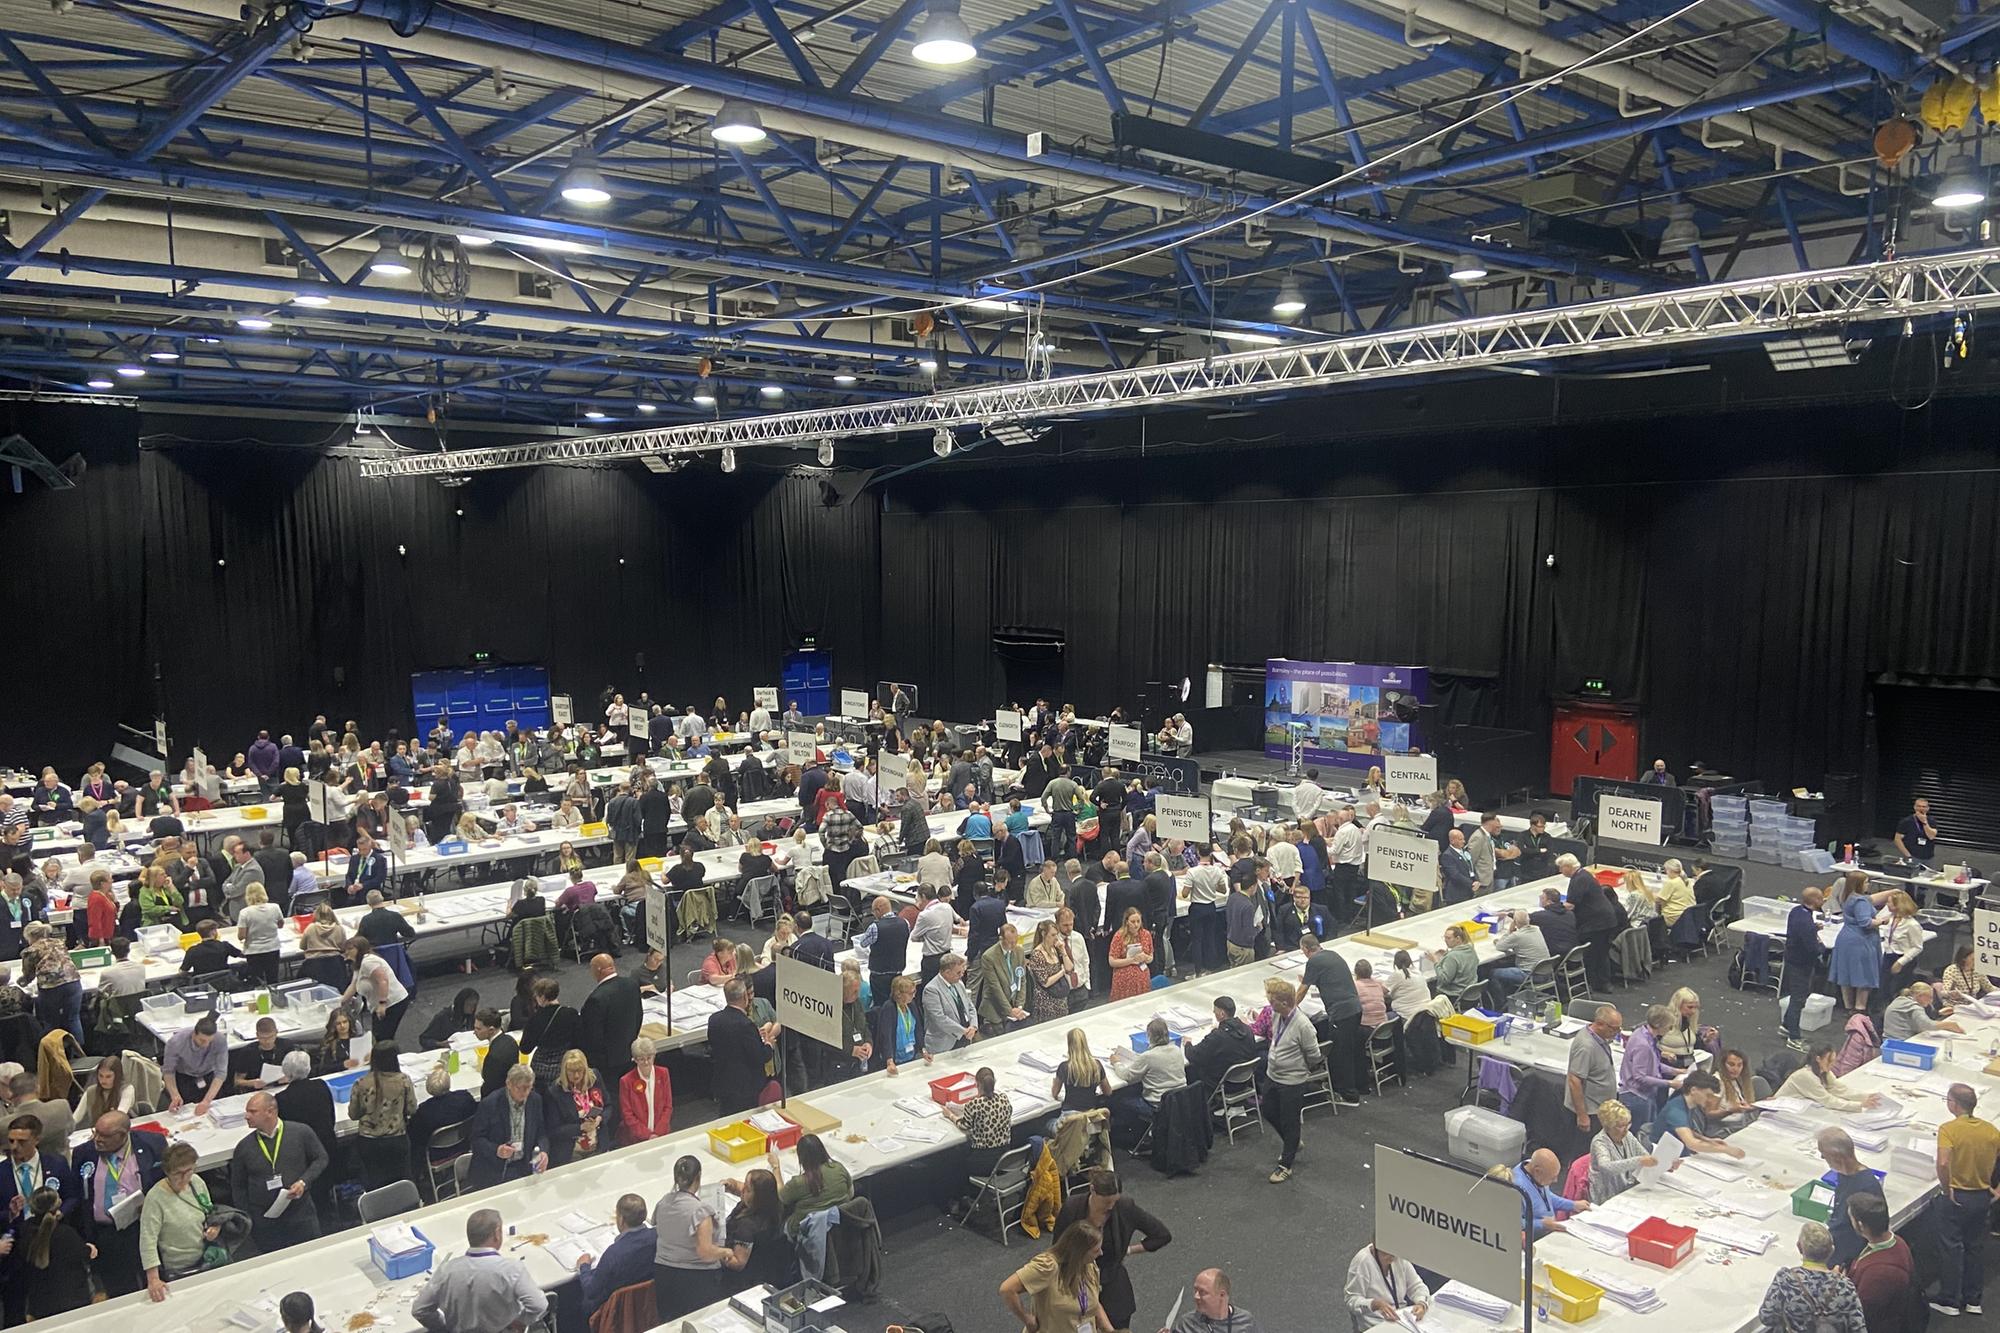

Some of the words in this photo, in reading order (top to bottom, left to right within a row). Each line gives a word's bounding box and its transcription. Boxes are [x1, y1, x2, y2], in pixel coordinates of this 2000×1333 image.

[1112, 738, 1137, 749] STAIRFOOT
[1390, 770, 1431, 781] CENTRAL
[1161, 807, 1203, 819] PENISTONE
[1608, 806, 1652, 821] DEARNE
[1171, 819, 1192, 828] WEST
[1611, 820, 1648, 833] NORTH
[1376, 845, 1429, 863] PENISTONE
[1390, 860, 1415, 872] EAST
[783, 988, 833, 1018] ROYSTON
[1388, 1193, 1508, 1253] WOMBWELL
